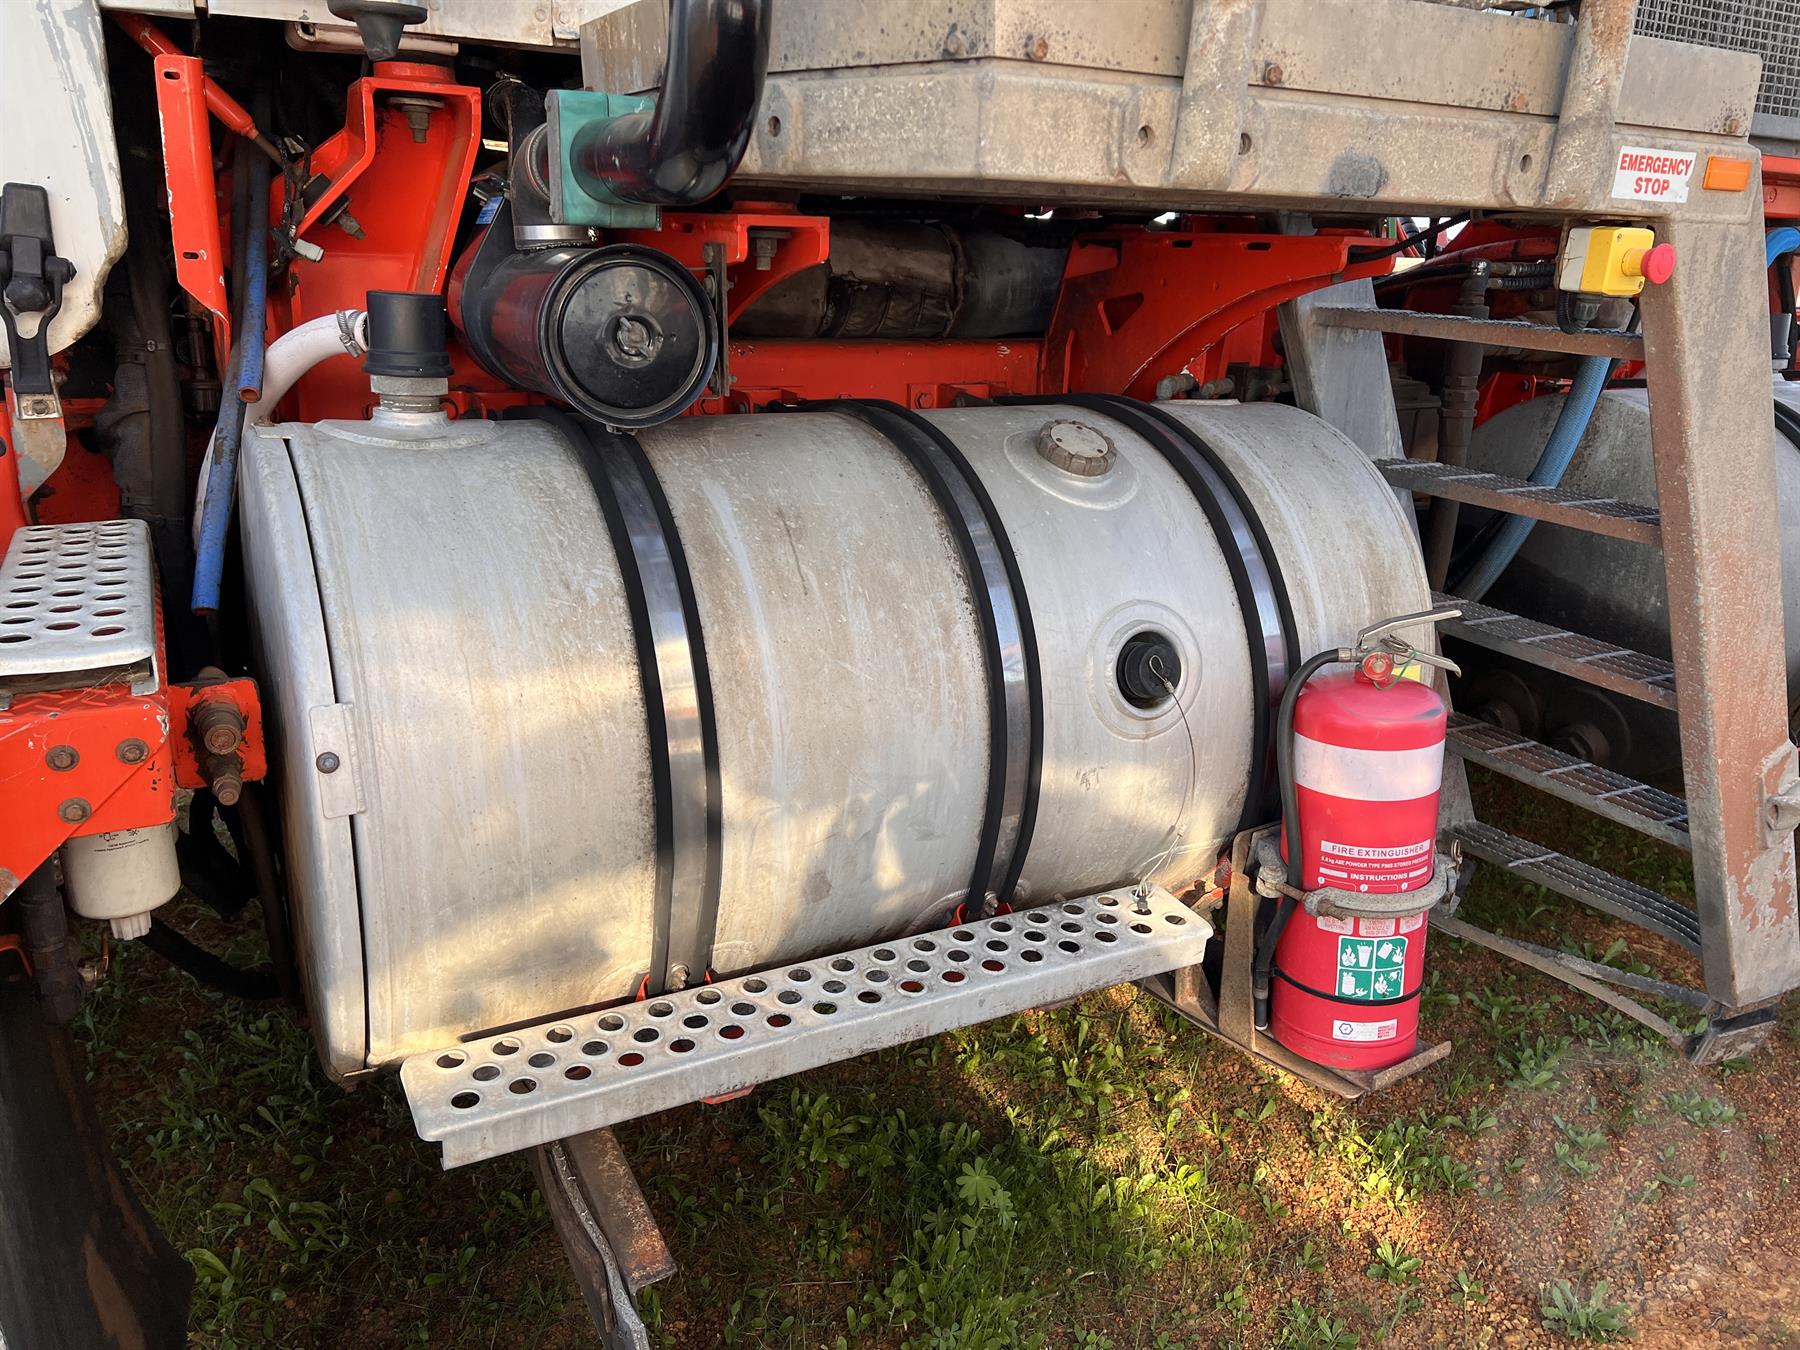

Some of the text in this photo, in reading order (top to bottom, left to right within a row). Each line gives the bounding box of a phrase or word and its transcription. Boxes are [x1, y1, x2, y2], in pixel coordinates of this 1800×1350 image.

[1620, 153, 1693, 176] EMERGENCY
[1634, 177, 1670, 195] STOP
[1332, 844, 1424, 857] FIRE EXTINGUISHER
[1350, 872, 1408, 881] INSTRUCTIONS
